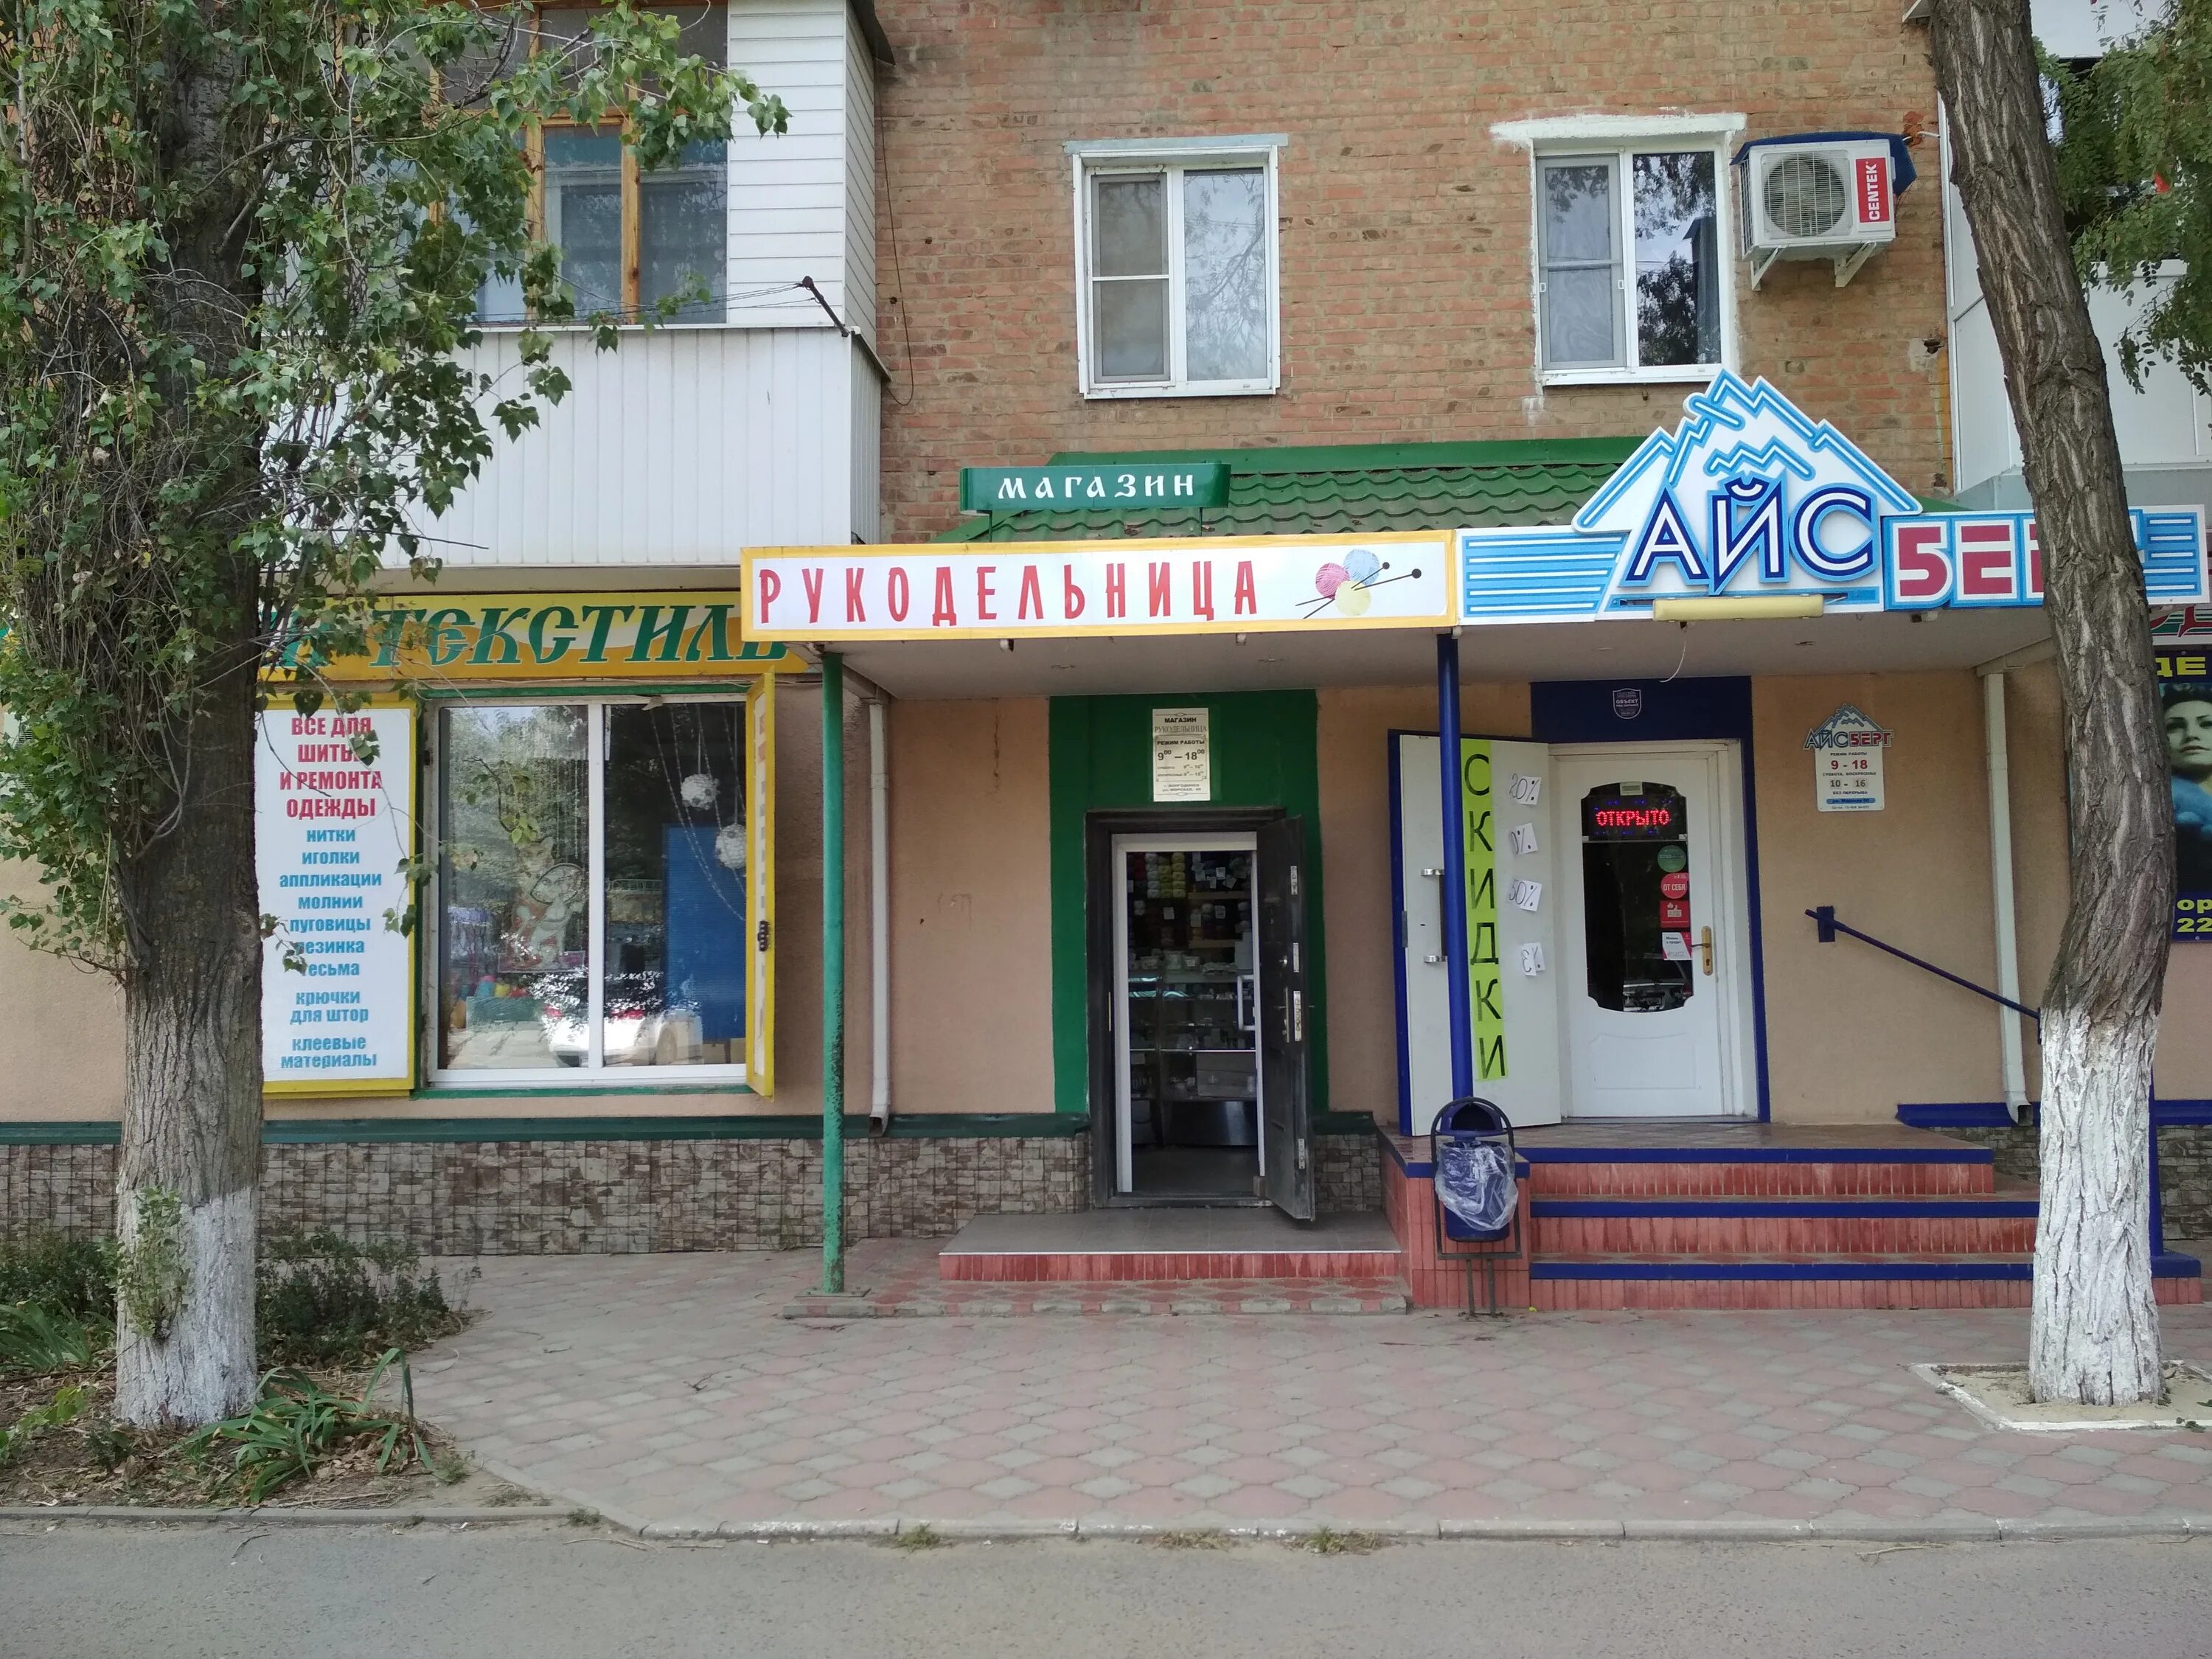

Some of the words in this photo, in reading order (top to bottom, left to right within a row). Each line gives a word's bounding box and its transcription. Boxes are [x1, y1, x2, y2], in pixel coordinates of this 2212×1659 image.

[1865, 164, 1881, 220] CENTEK
[1626, 476, 2045, 599] АЙСБЕ
[758, 559, 1258, 627] РУКОДЕЛЬНИЦА
[291, 717, 326, 736] ВСЕ
[330, 717, 372, 738] ДЛЯ
[1155, 725, 1207, 733] РУКОДЕЛЬНИЦА
[1804, 728, 1891, 751] АЙСБЕРГ
[298, 744, 360, 763] ШИТЬ
[1831, 759, 1839, 770] 9
[1851, 759, 1868, 770] 18
[279, 771, 292, 790] И
[296, 771, 383, 790] РЕМОНТА
[1509, 773, 1540, 802] 20%
[1830, 779, 1841, 787] 10
[286, 798, 376, 820] ОДЕЖДЫ
[1596, 810, 1670, 826] ОТКРЫТО
[307, 830, 355, 842] нитки
[302, 852, 360, 865] иголки
[279, 873, 382, 888] аппликации
[1663, 883, 1671, 891] ОТ
[1672, 883, 1686, 891] СЕБЯ
[298, 896, 364, 909] молнии
[1464, 753, 1506, 1079] СКИДКИ
[289, 918, 371, 933] пуговицы
[296, 940, 365, 954] езинка
[302, 963, 360, 976] есьма
[296, 991, 361, 1006] крючки
[290, 1009, 322, 1025] для
[327, 1008, 369, 1023] штор
[292, 1037, 366, 1051] клеевые
[281, 1054, 377, 1068] материалы
